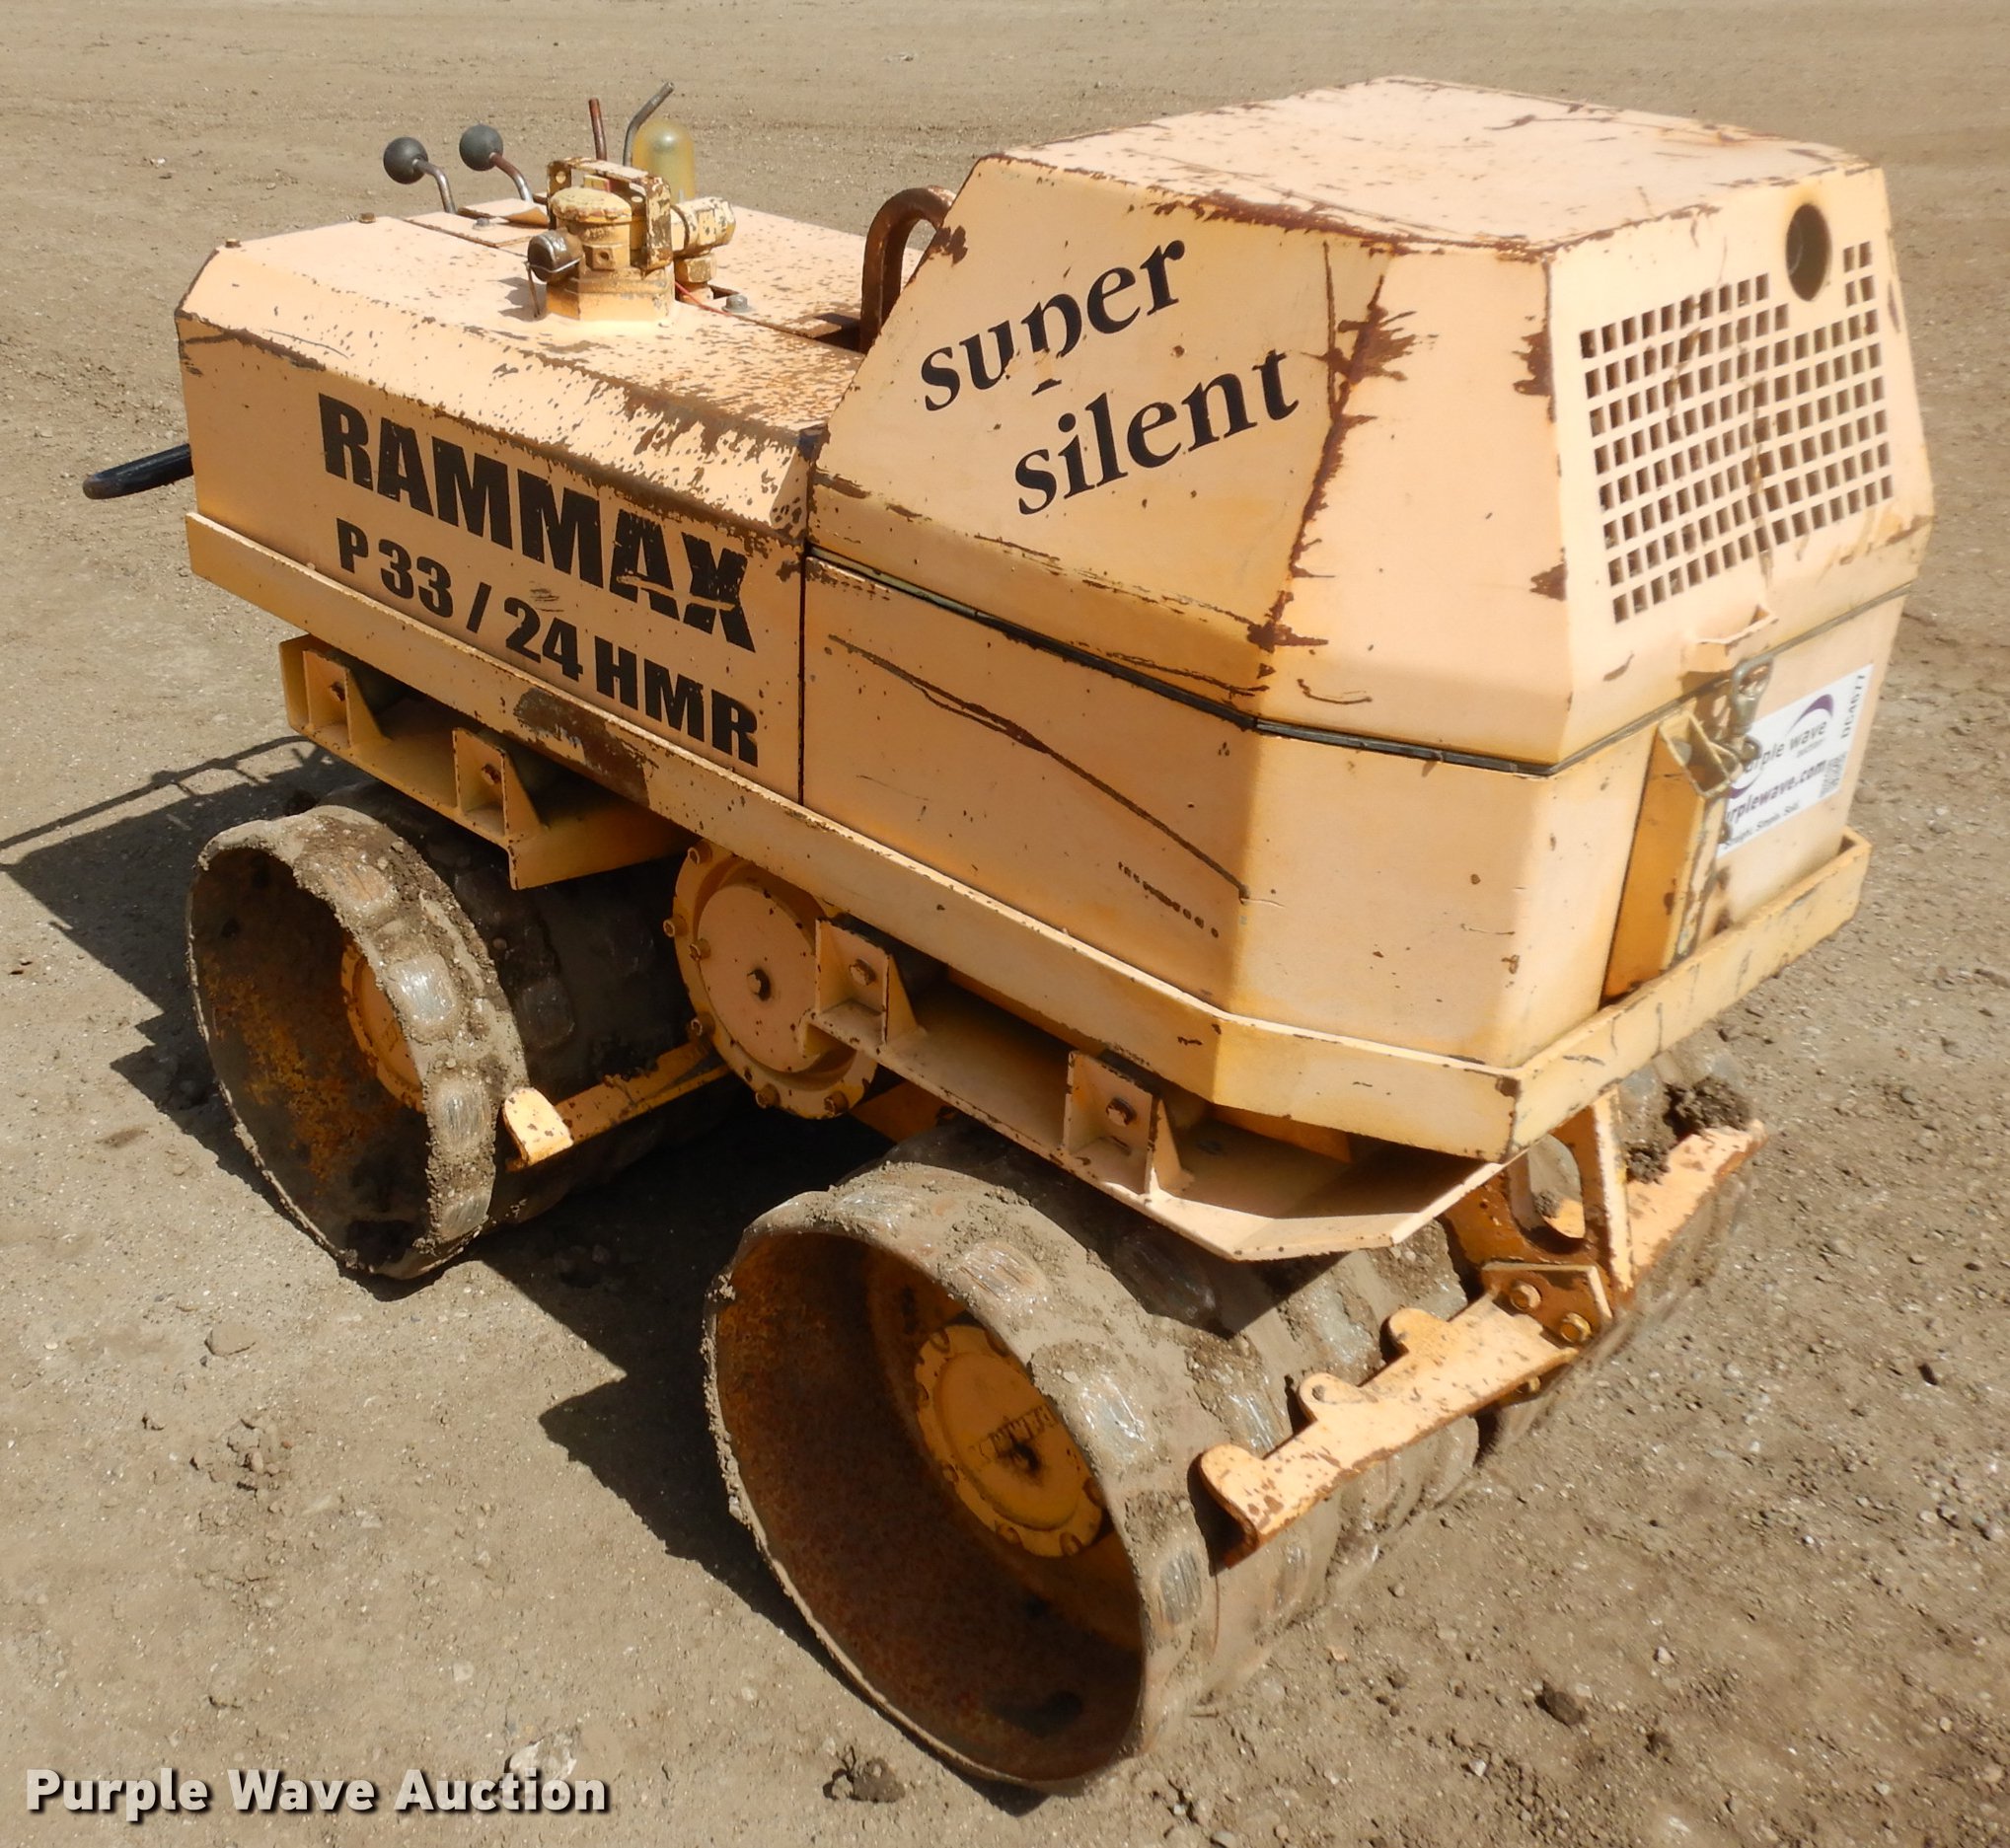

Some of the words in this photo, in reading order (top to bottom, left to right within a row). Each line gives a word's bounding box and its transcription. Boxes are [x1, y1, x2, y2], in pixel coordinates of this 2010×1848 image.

[921, 240, 1186, 412] super
[1014, 348, 1300, 515] silent
[318, 392, 756, 653] RAMMAX
[594, 635, 759, 768] HMR
[1789, 720, 1827, 750] wave
